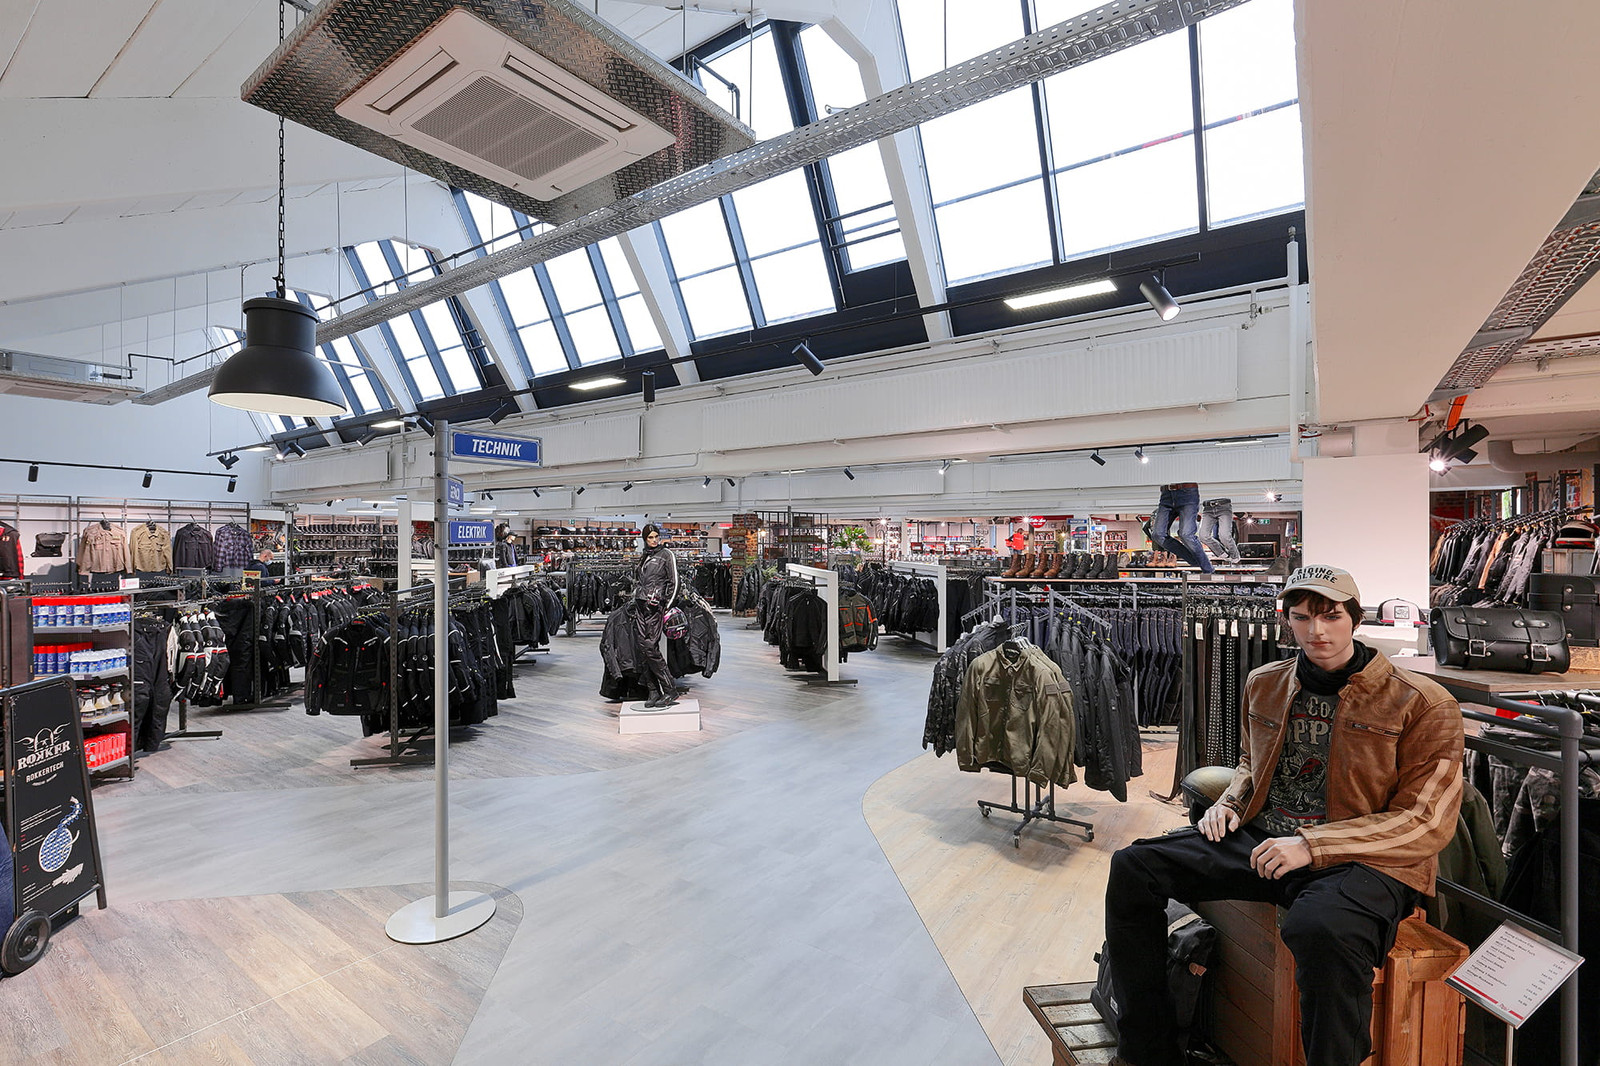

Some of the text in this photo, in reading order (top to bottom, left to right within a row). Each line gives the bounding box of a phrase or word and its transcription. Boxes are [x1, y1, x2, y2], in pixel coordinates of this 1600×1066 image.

[472, 439, 522, 457] TECHNIK
[458, 526, 487, 539] ELEKTRIK
[1298, 567, 1332, 576] RIDING
[1291, 573, 1338, 584] CULTURE
[26, 761, 64, 783] ROKKERTECH
